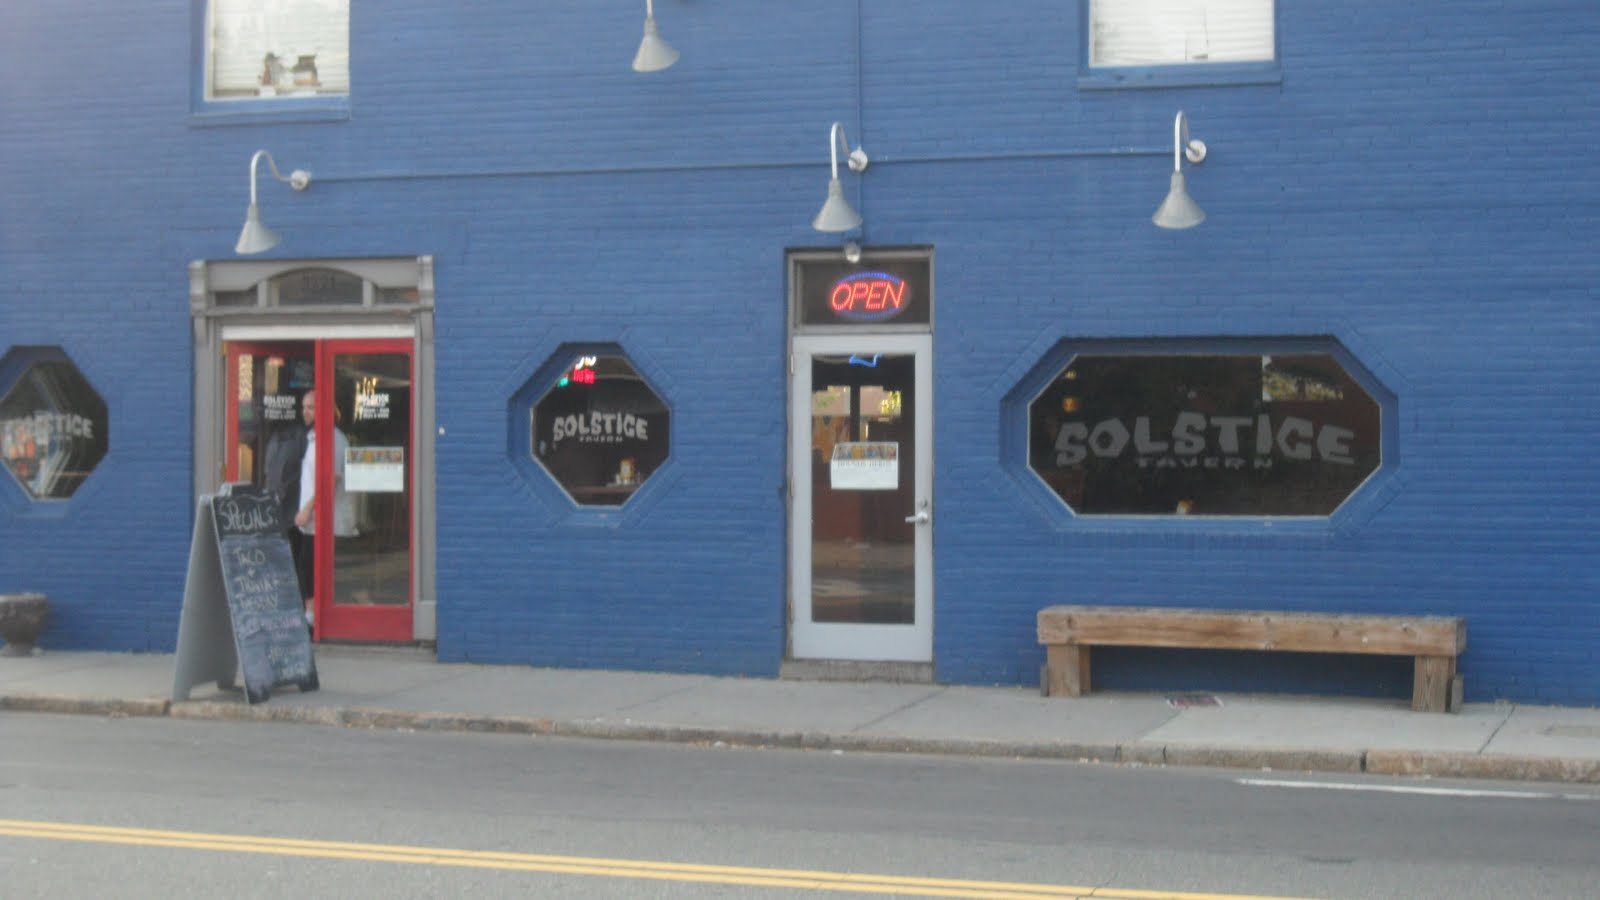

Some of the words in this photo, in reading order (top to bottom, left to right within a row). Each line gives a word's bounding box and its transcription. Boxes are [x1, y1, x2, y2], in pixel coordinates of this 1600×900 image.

[831, 280, 905, 311] OPEN
[553, 411, 649, 442] SOLSTICE
[1054, 411, 1355, 467] SOLSTICE
[1135, 456, 1273, 471] TAVERN
